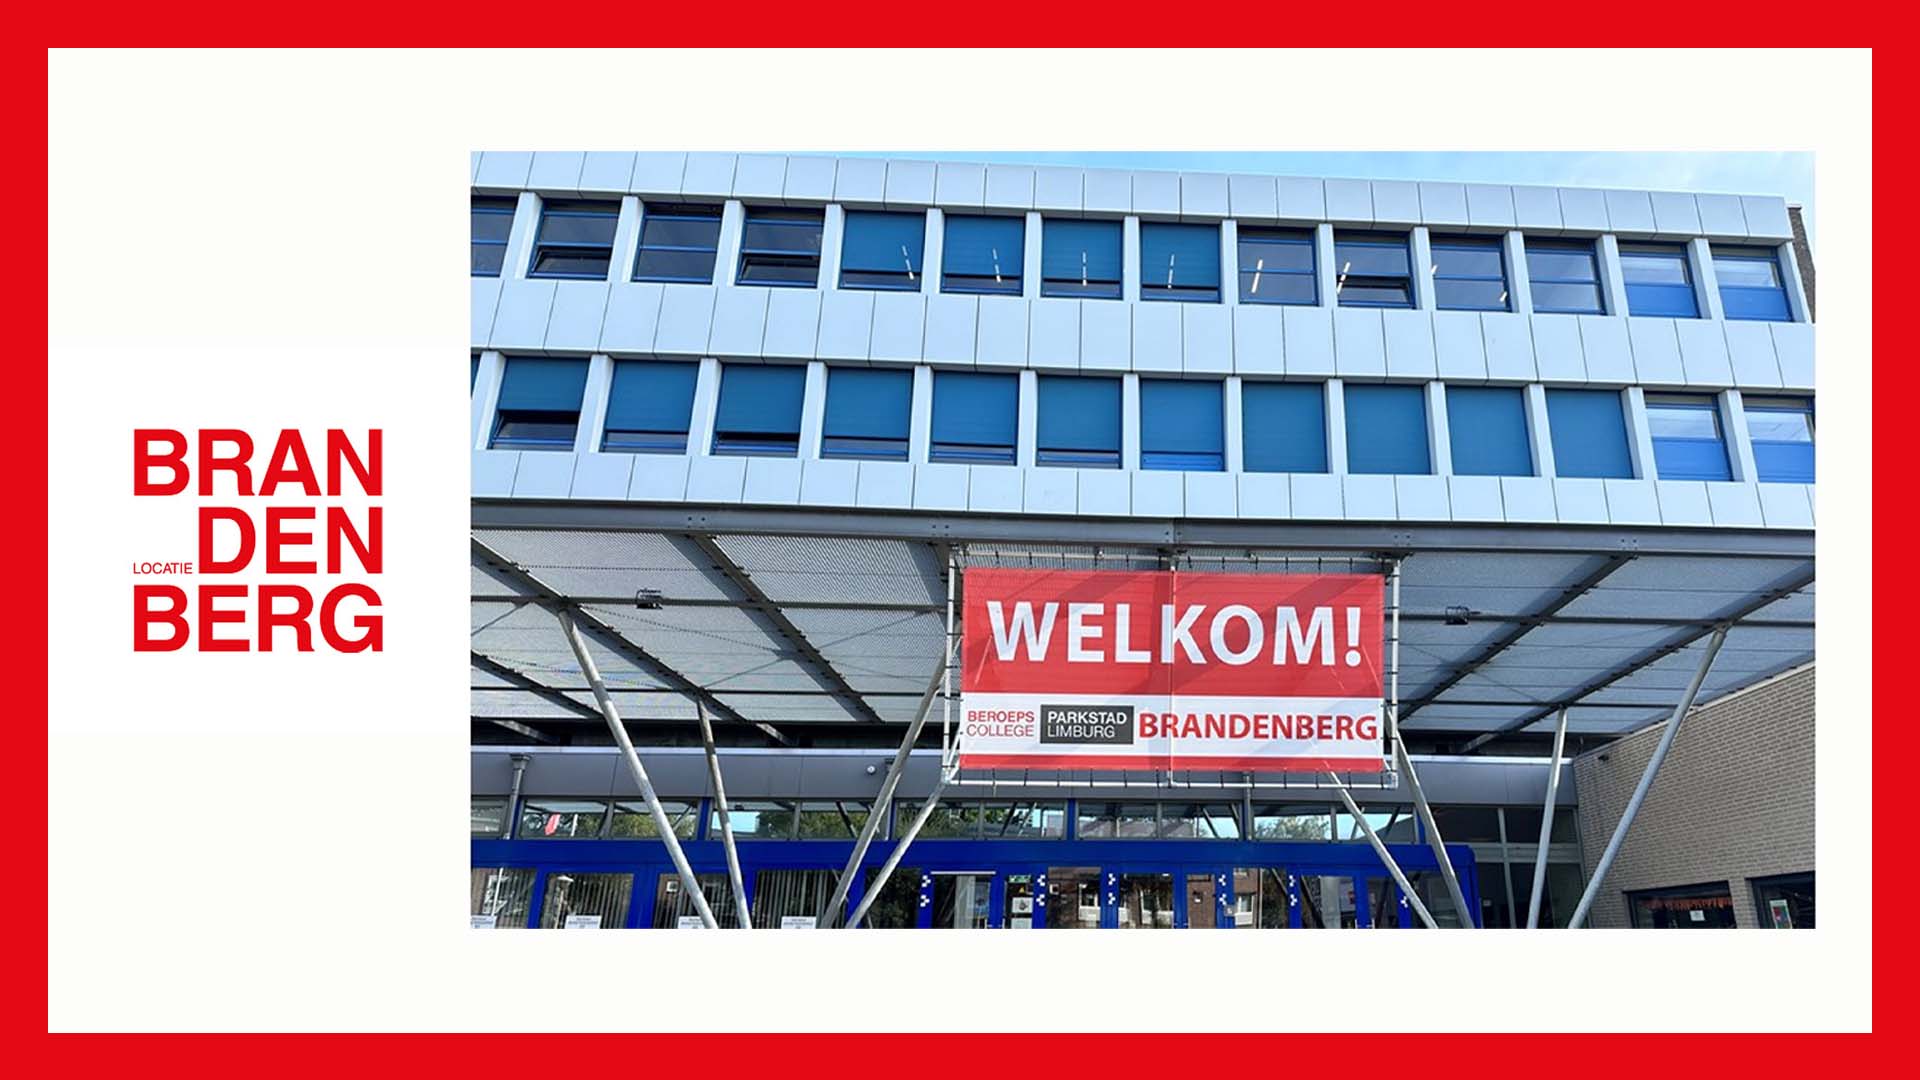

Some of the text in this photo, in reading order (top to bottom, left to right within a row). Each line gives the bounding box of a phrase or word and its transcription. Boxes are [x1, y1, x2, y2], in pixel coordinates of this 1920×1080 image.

[986, 600, 1362, 667] WELKOM!
[967, 710, 1035, 723] BEROEPS
[1047, 711, 1127, 725] PARKSTAD
[966, 724, 1035, 738] COLLEGE
[1047, 725, 1116, 738] LIMBURG
[1138, 713, 1378, 741] BRANDENBERG
